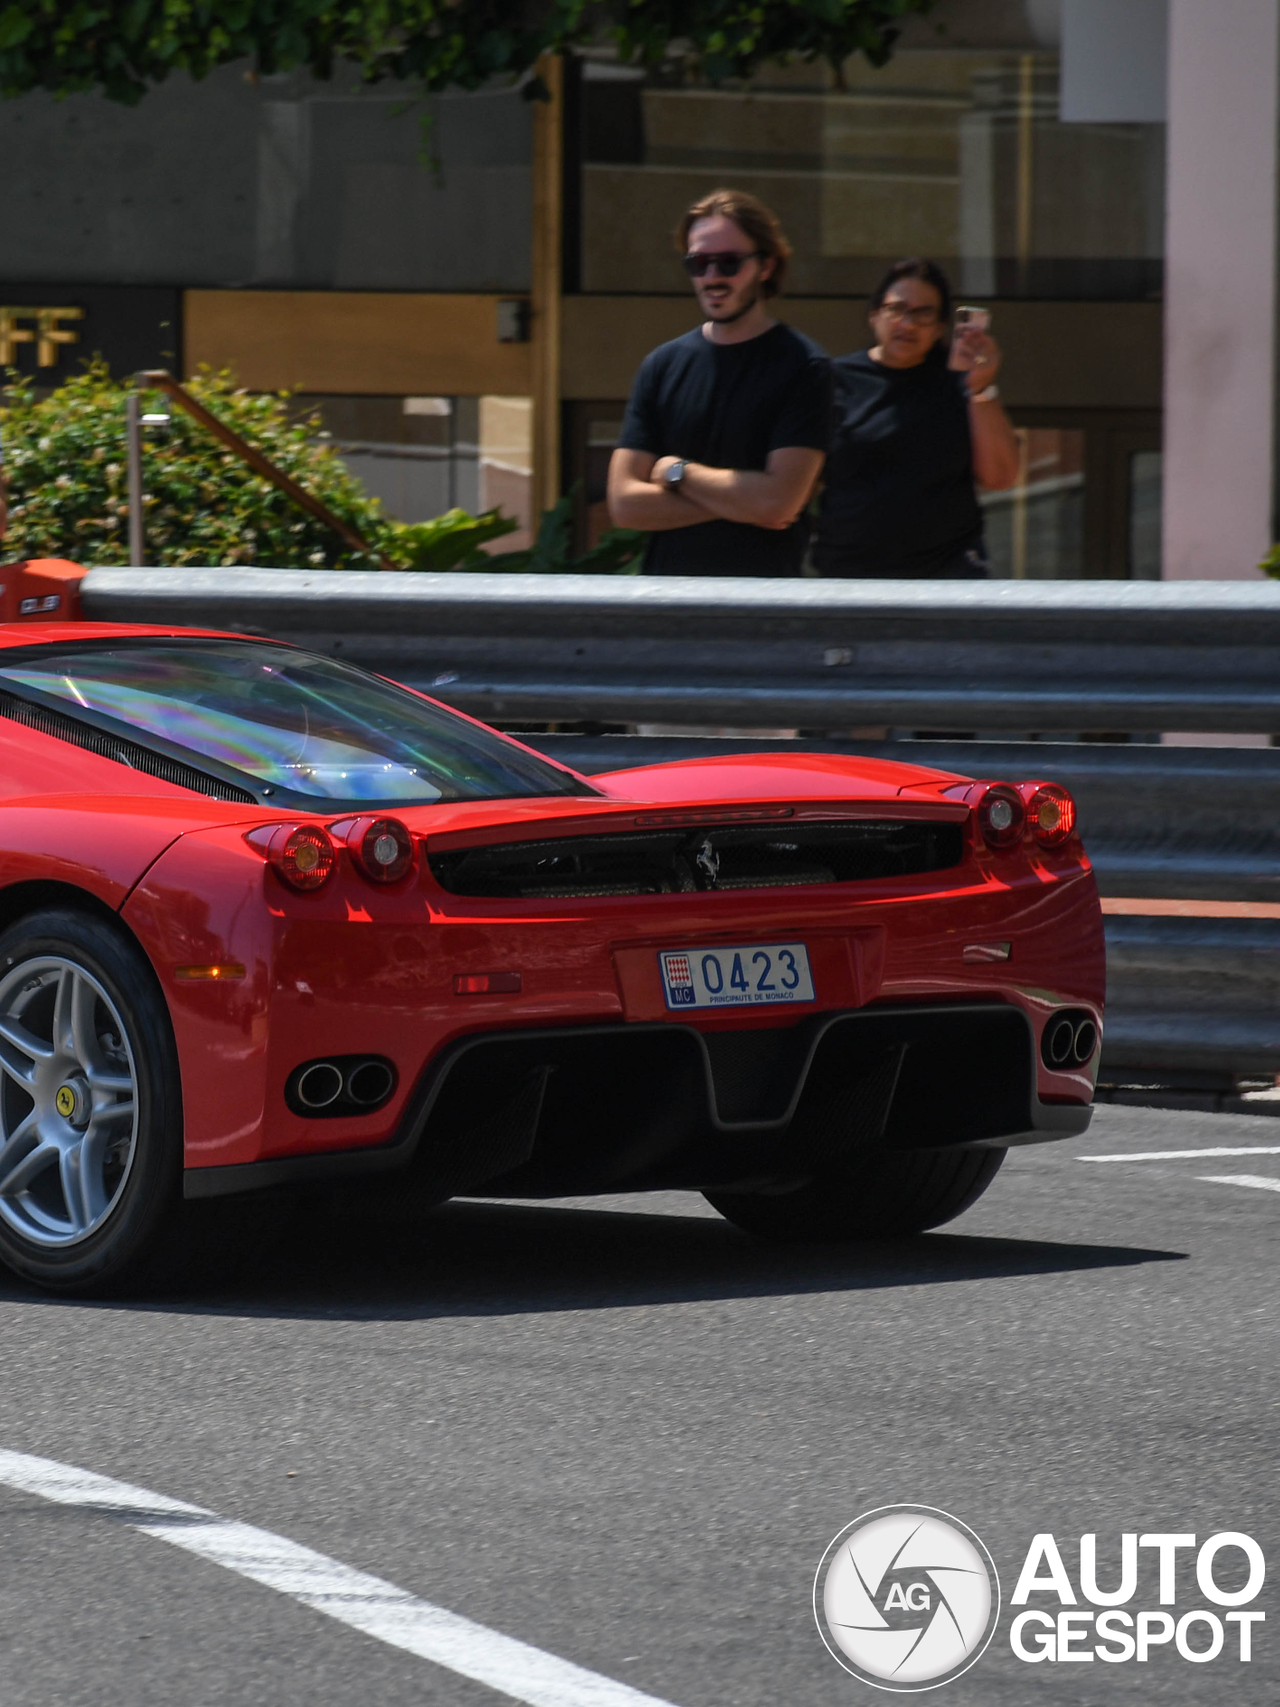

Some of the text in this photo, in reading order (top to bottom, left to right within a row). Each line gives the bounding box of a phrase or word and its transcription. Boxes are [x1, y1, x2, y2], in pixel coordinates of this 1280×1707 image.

[701, 950, 800, 994] 0423
[675, 989, 691, 1002] MC
[709, 991, 794, 1004] PRINCIPAUTE DE MONACO
